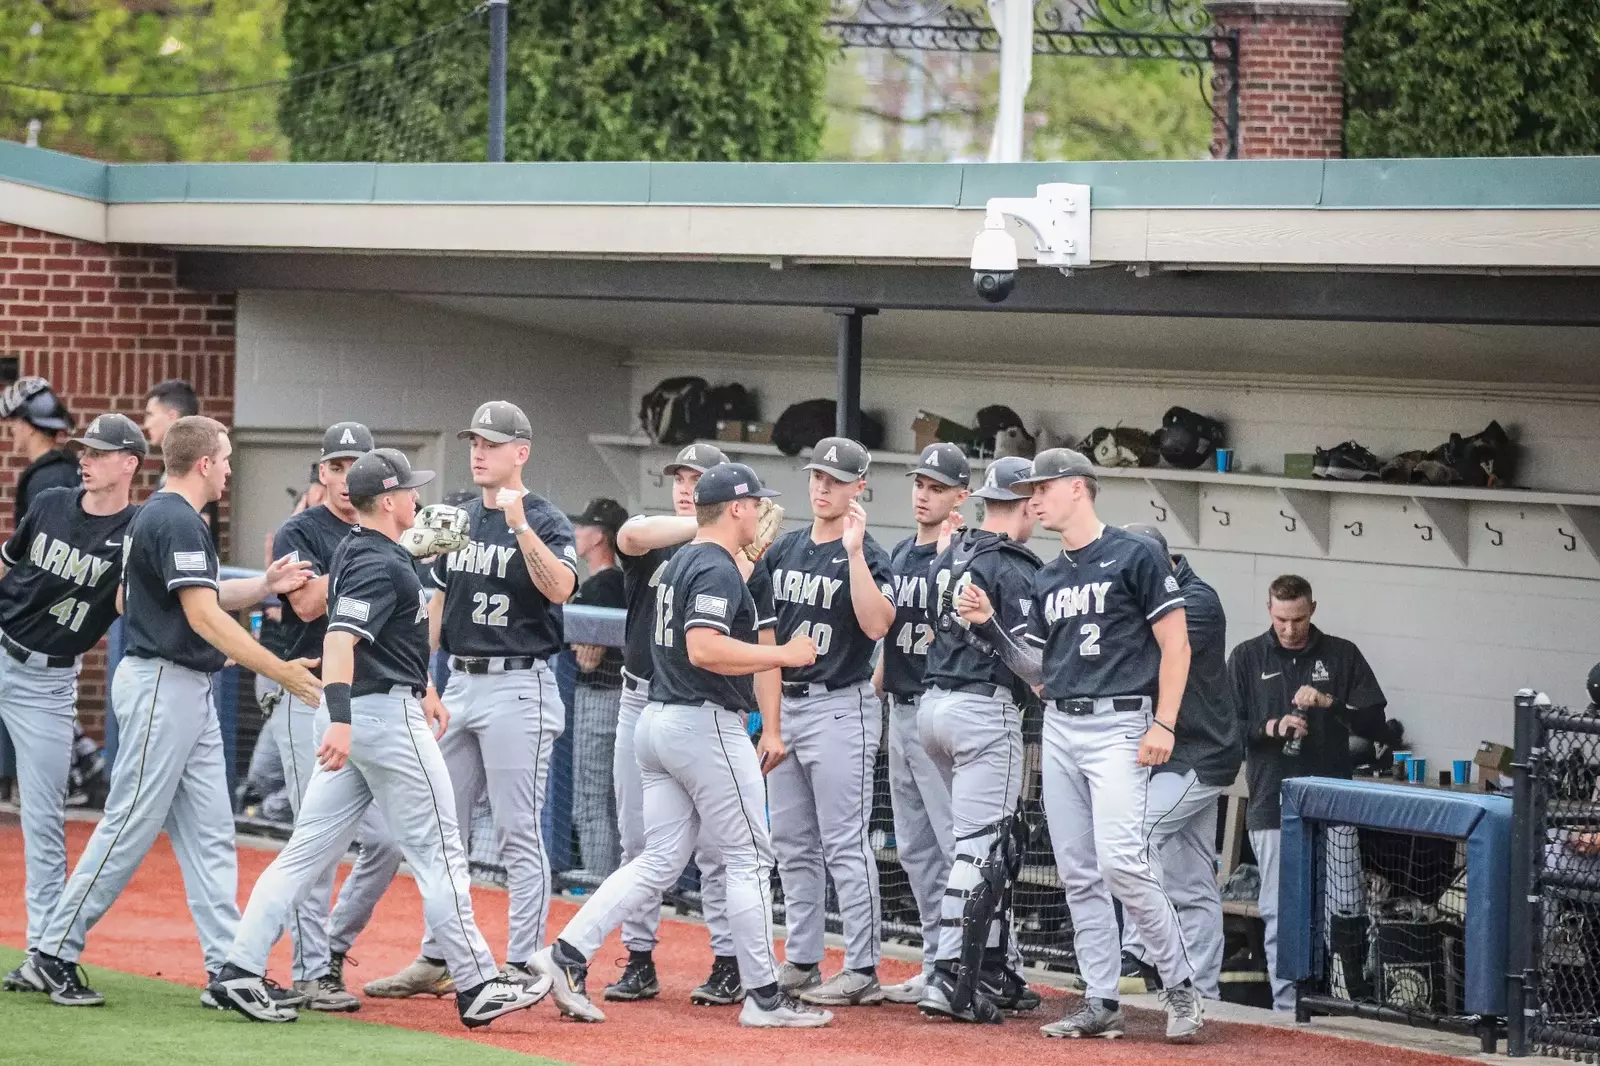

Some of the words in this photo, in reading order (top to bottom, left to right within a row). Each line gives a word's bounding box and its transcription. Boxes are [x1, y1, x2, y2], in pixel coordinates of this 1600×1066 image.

[479, 408, 493, 424] A
[340, 429, 356, 444] A
[684, 446, 697, 460] A
[824, 446, 838, 462] A
[925, 450, 939, 467] A
[985, 468, 998, 488] A
[30, 532, 112, 587] ARMY
[447, 542, 516, 578] ARMY
[773, 569, 843, 609] ARMY
[1045, 582, 1111, 624] ARMY
[49, 597, 90, 633] 41
[472, 592, 510, 626] 22
[655, 584, 674, 647] 12
[897, 622, 929, 654] 42
[1080, 624, 1100, 655] 2
